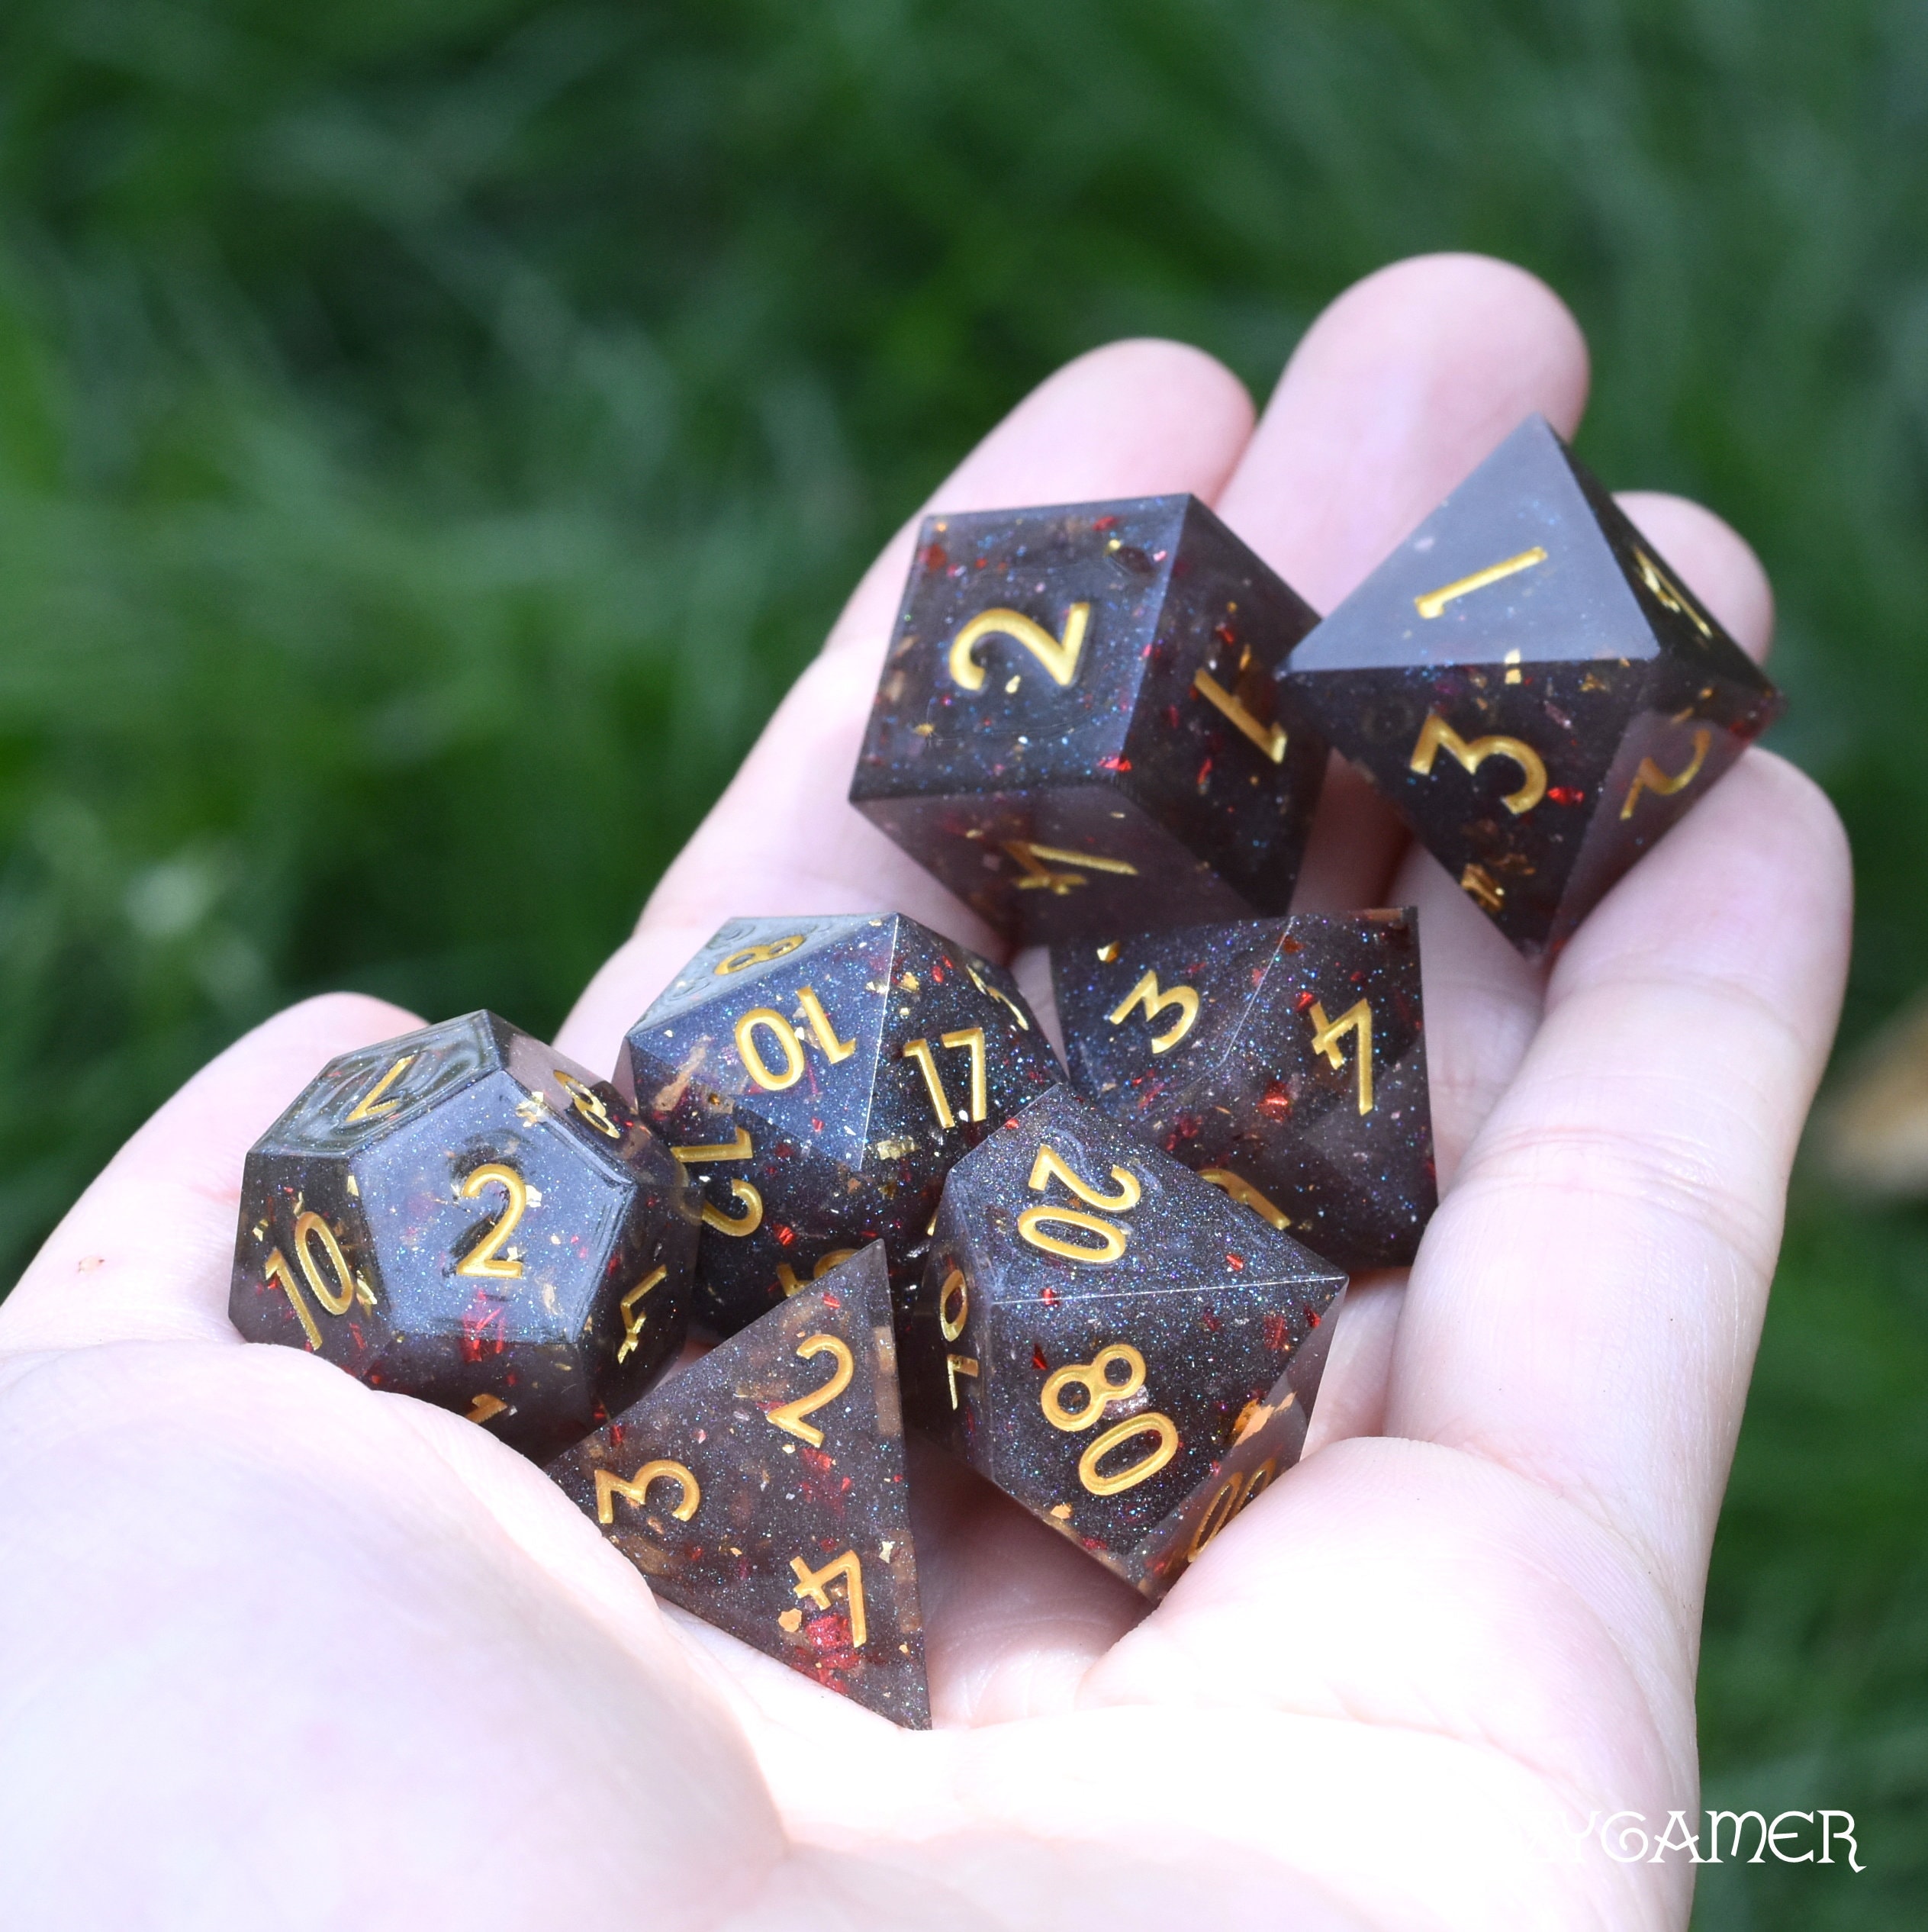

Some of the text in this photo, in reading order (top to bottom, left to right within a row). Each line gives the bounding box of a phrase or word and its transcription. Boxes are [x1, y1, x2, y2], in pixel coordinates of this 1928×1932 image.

[1413, 545, 1548, 620] 1
[948, 602, 1090, 691] 2
[1194, 667, 1288, 764] 1
[1410, 712, 1548, 815] 3
[713, 934, 806, 977] 8
[734, 986, 857, 1092] 10
[1108, 968, 1200, 1055] 3
[1308, 997, 1373, 1117] 4
[903, 1027, 987, 1129] 17
[455, 1163, 528, 1280] 2
[1018, 1144, 1141, 1264] 20
[265, 1211, 354, 1350] 10
[617, 1263, 668, 1365] 4
[765, 1333, 855, 1448] 2
[1040, 1343, 1180, 1497] 80
[594, 1459, 701, 1525] 3
[788, 1548, 867, 1648] 4
